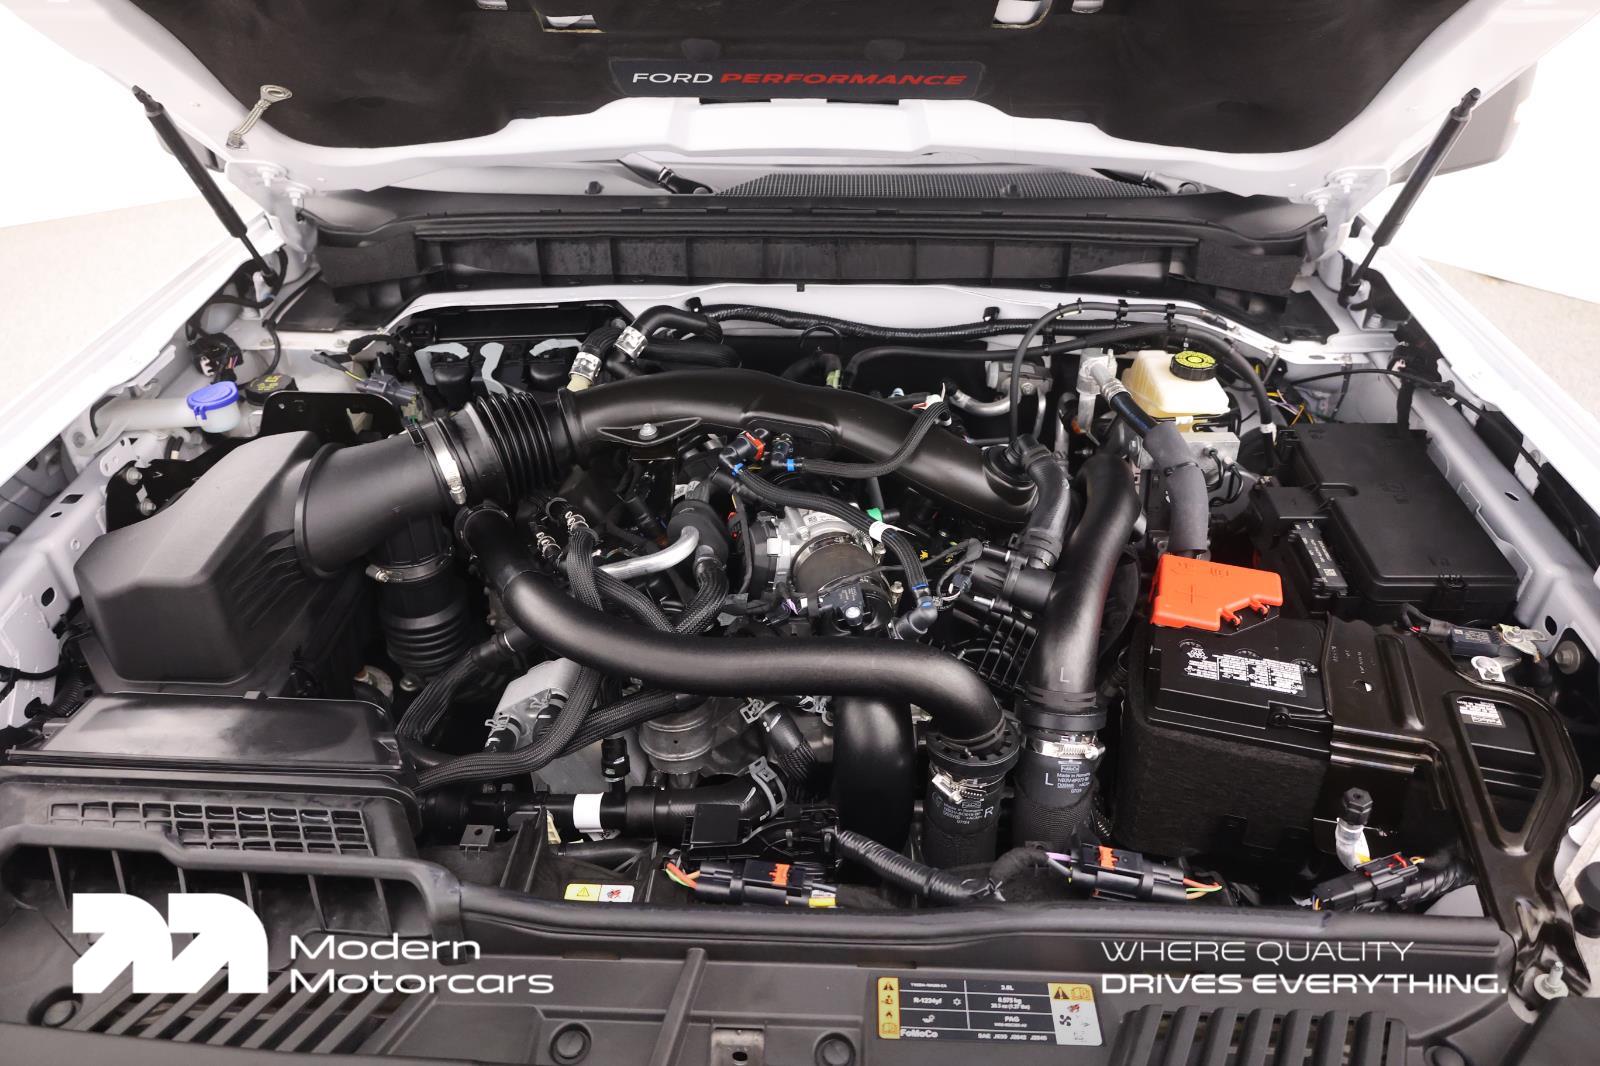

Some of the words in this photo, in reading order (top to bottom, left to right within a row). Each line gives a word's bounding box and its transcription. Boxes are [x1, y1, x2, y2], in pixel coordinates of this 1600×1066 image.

[632, 72, 714, 84] FORD
[719, 73, 967, 87] PERFORMANCE
[1044, 772, 1054, 786] L
[984, 805, 994, 818] R
[1004, 1015, 1021, 1023] PAG
[900, 1028, 939, 1038] FoMoCo
